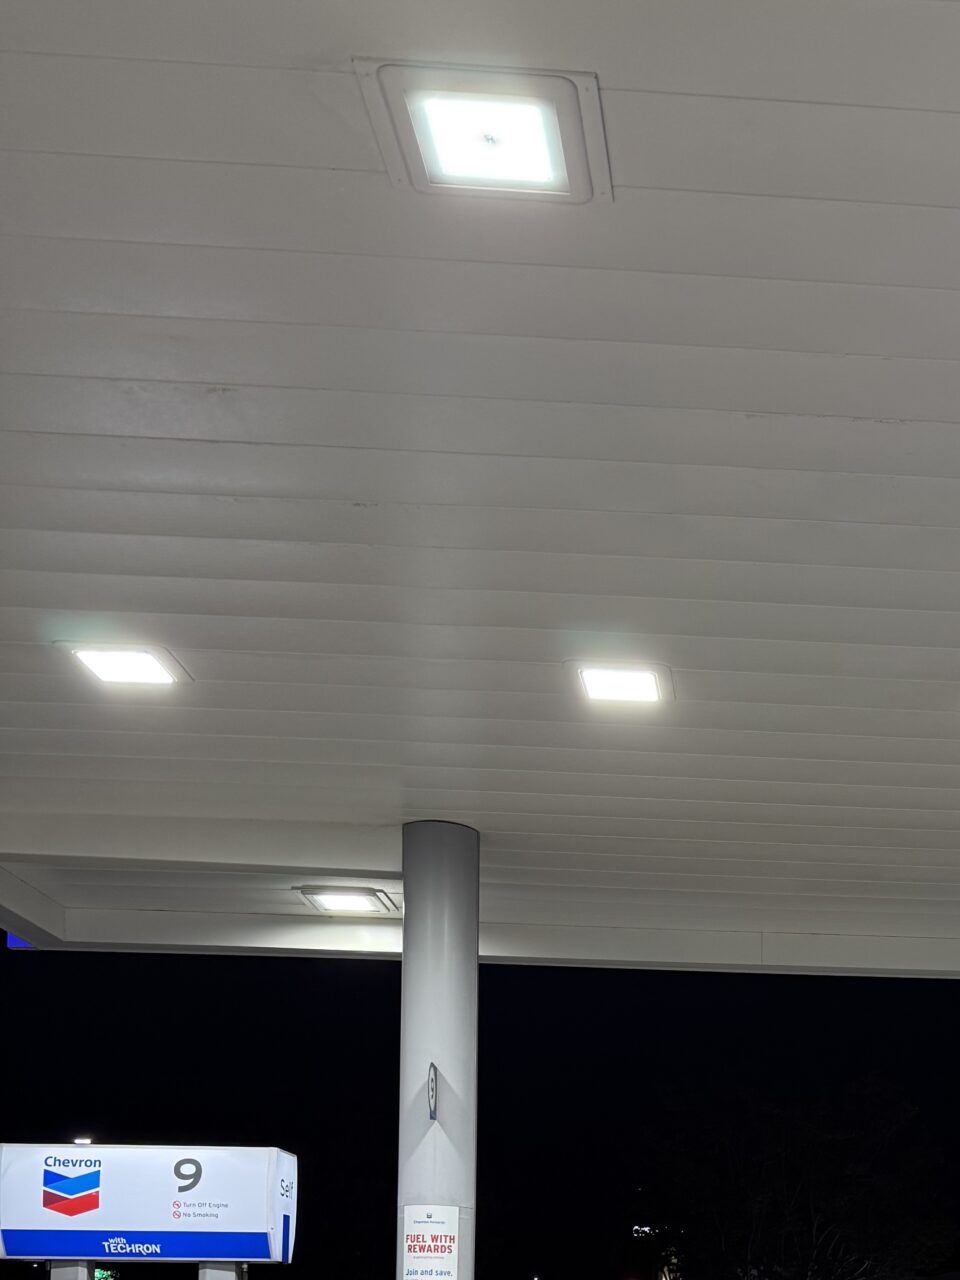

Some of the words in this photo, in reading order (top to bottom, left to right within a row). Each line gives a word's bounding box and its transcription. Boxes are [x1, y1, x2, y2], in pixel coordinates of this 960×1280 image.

[44, 1156, 102, 1168] Chevron
[173, 1158, 203, 1193] 9
[406, 1233, 427, 1243] FUEL
[430, 1234, 455, 1244] WITH
[102, 1241, 161, 1255] TECHRON
[407, 1244, 453, 1254] REWARDS
[405, 1268, 419, 1276] Join
